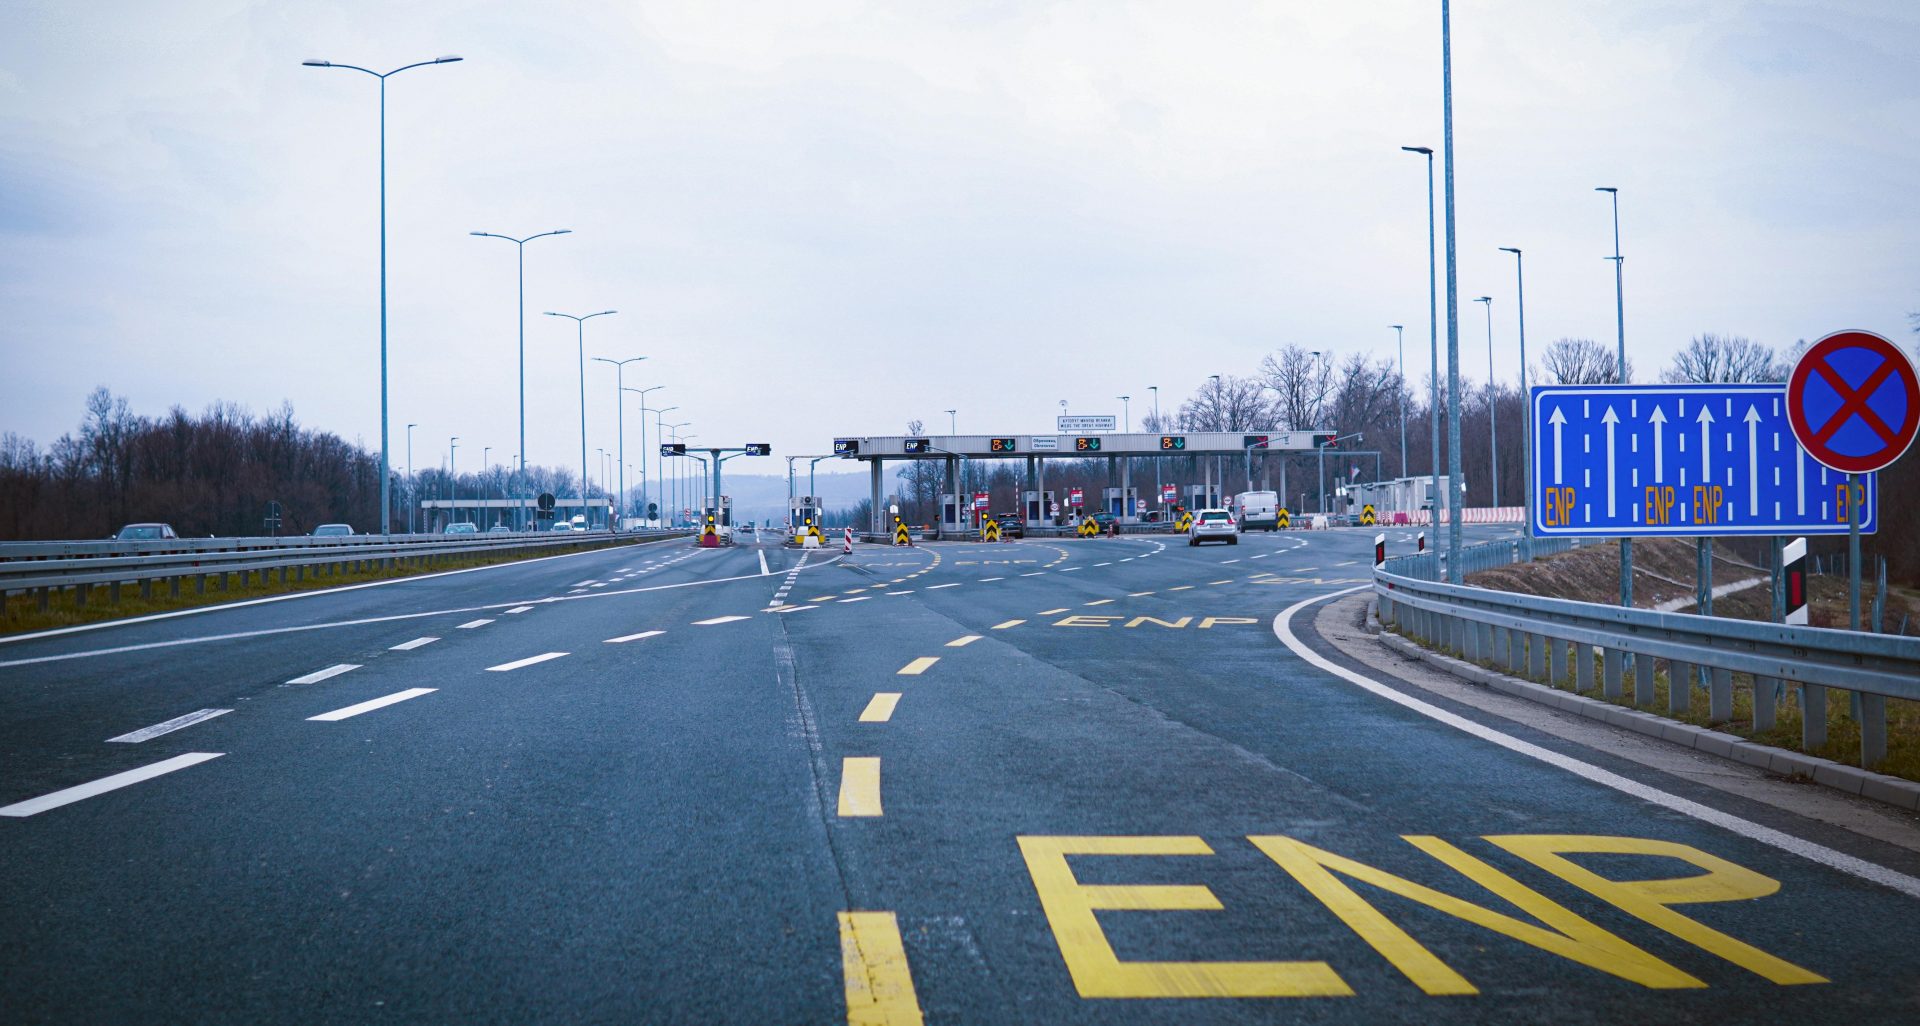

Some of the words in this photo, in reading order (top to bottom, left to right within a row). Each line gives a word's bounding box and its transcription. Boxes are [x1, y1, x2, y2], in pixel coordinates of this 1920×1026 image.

[835, 443, 847, 451] ENP
[1545, 487, 1576, 526] ENP
[1645, 486, 1675, 525] ENP
[1693, 485, 1723, 524] ENP
[1052, 615, 1258, 628] ENP
[1016, 834, 1831, 997] ENP
